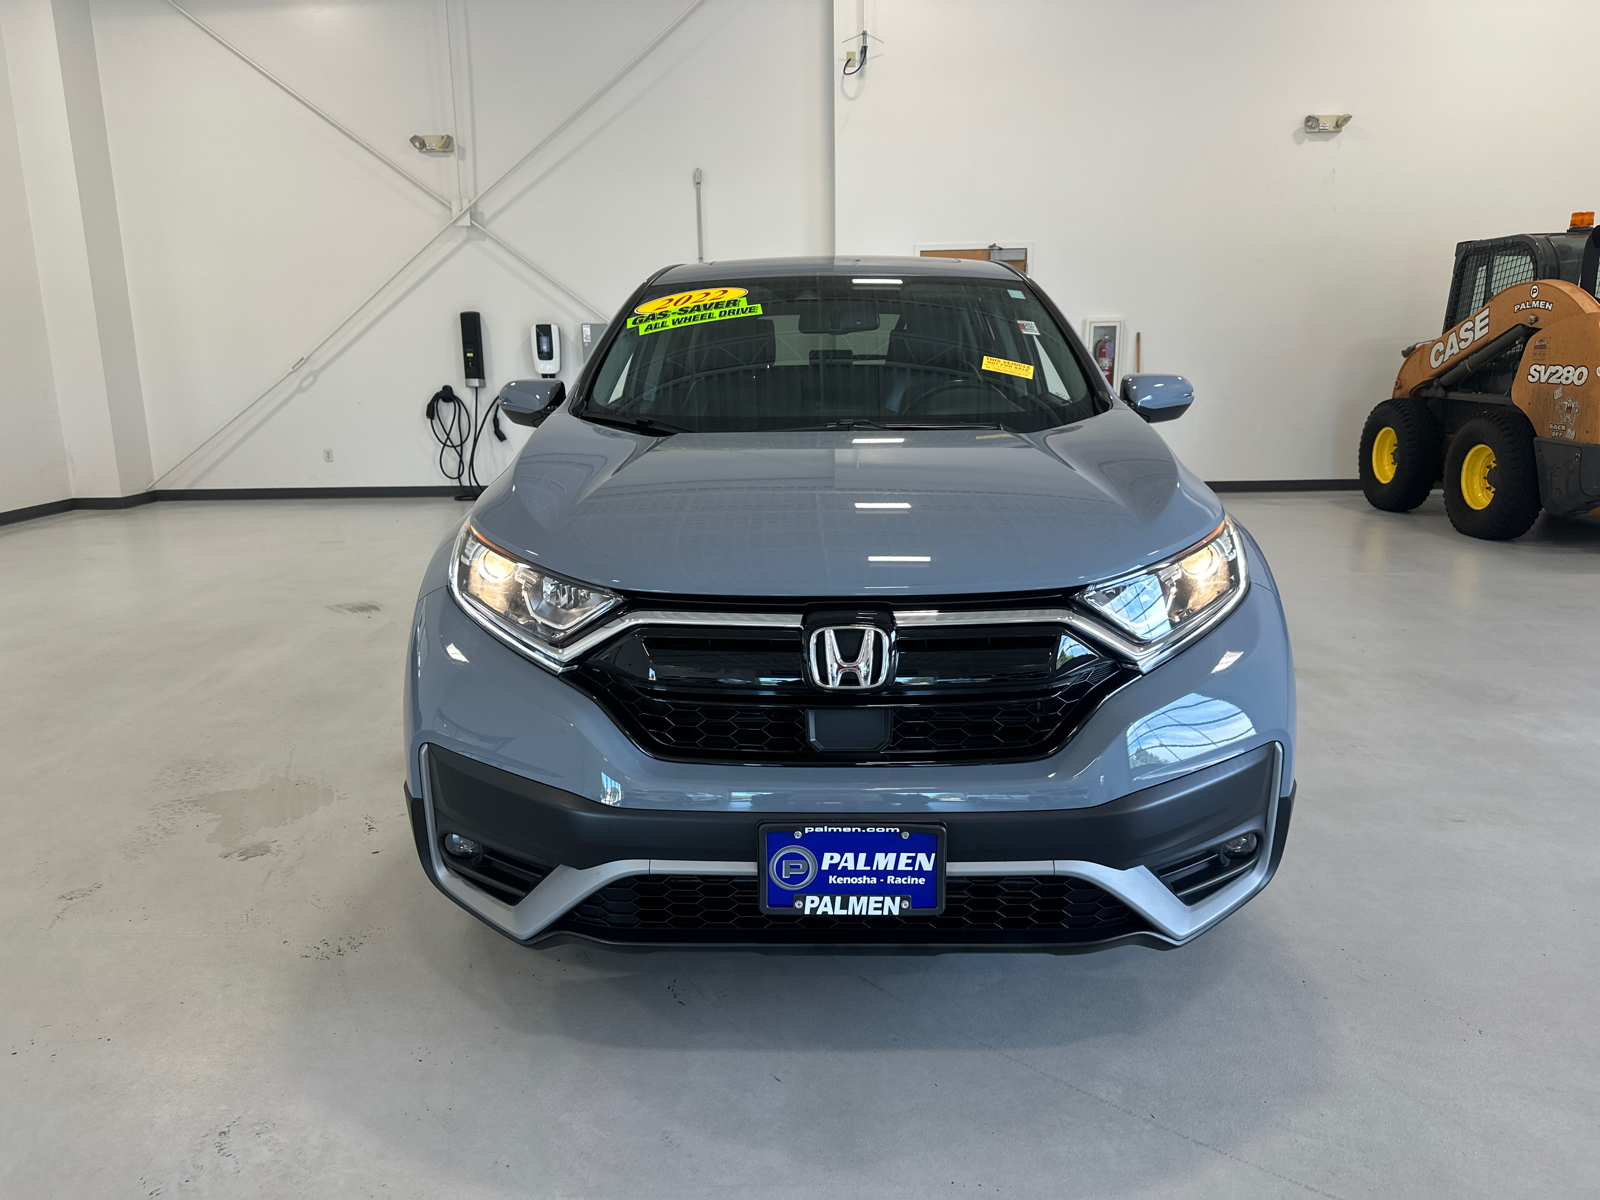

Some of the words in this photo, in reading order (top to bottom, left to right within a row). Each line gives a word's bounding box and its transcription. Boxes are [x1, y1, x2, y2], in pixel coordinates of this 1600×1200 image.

[655, 289, 728, 311] 2022
[1514, 300, 1553, 313] PALMEN
[632, 299, 741, 325] GAS-SAVER
[644, 320, 669, 332] ALL
[672, 312, 717, 325] WHEEL
[718, 306, 759, 318] DRIVE
[1430, 307, 1490, 368] CASE
[1527, 364, 1588, 386] SV280
[804, 826, 900, 834] palmen.com
[821, 852, 935, 871] PALMEN
[829, 875, 877, 884] Kenosha
[887, 875, 925, 884] Racine
[804, 895, 900, 915] PALMEN
